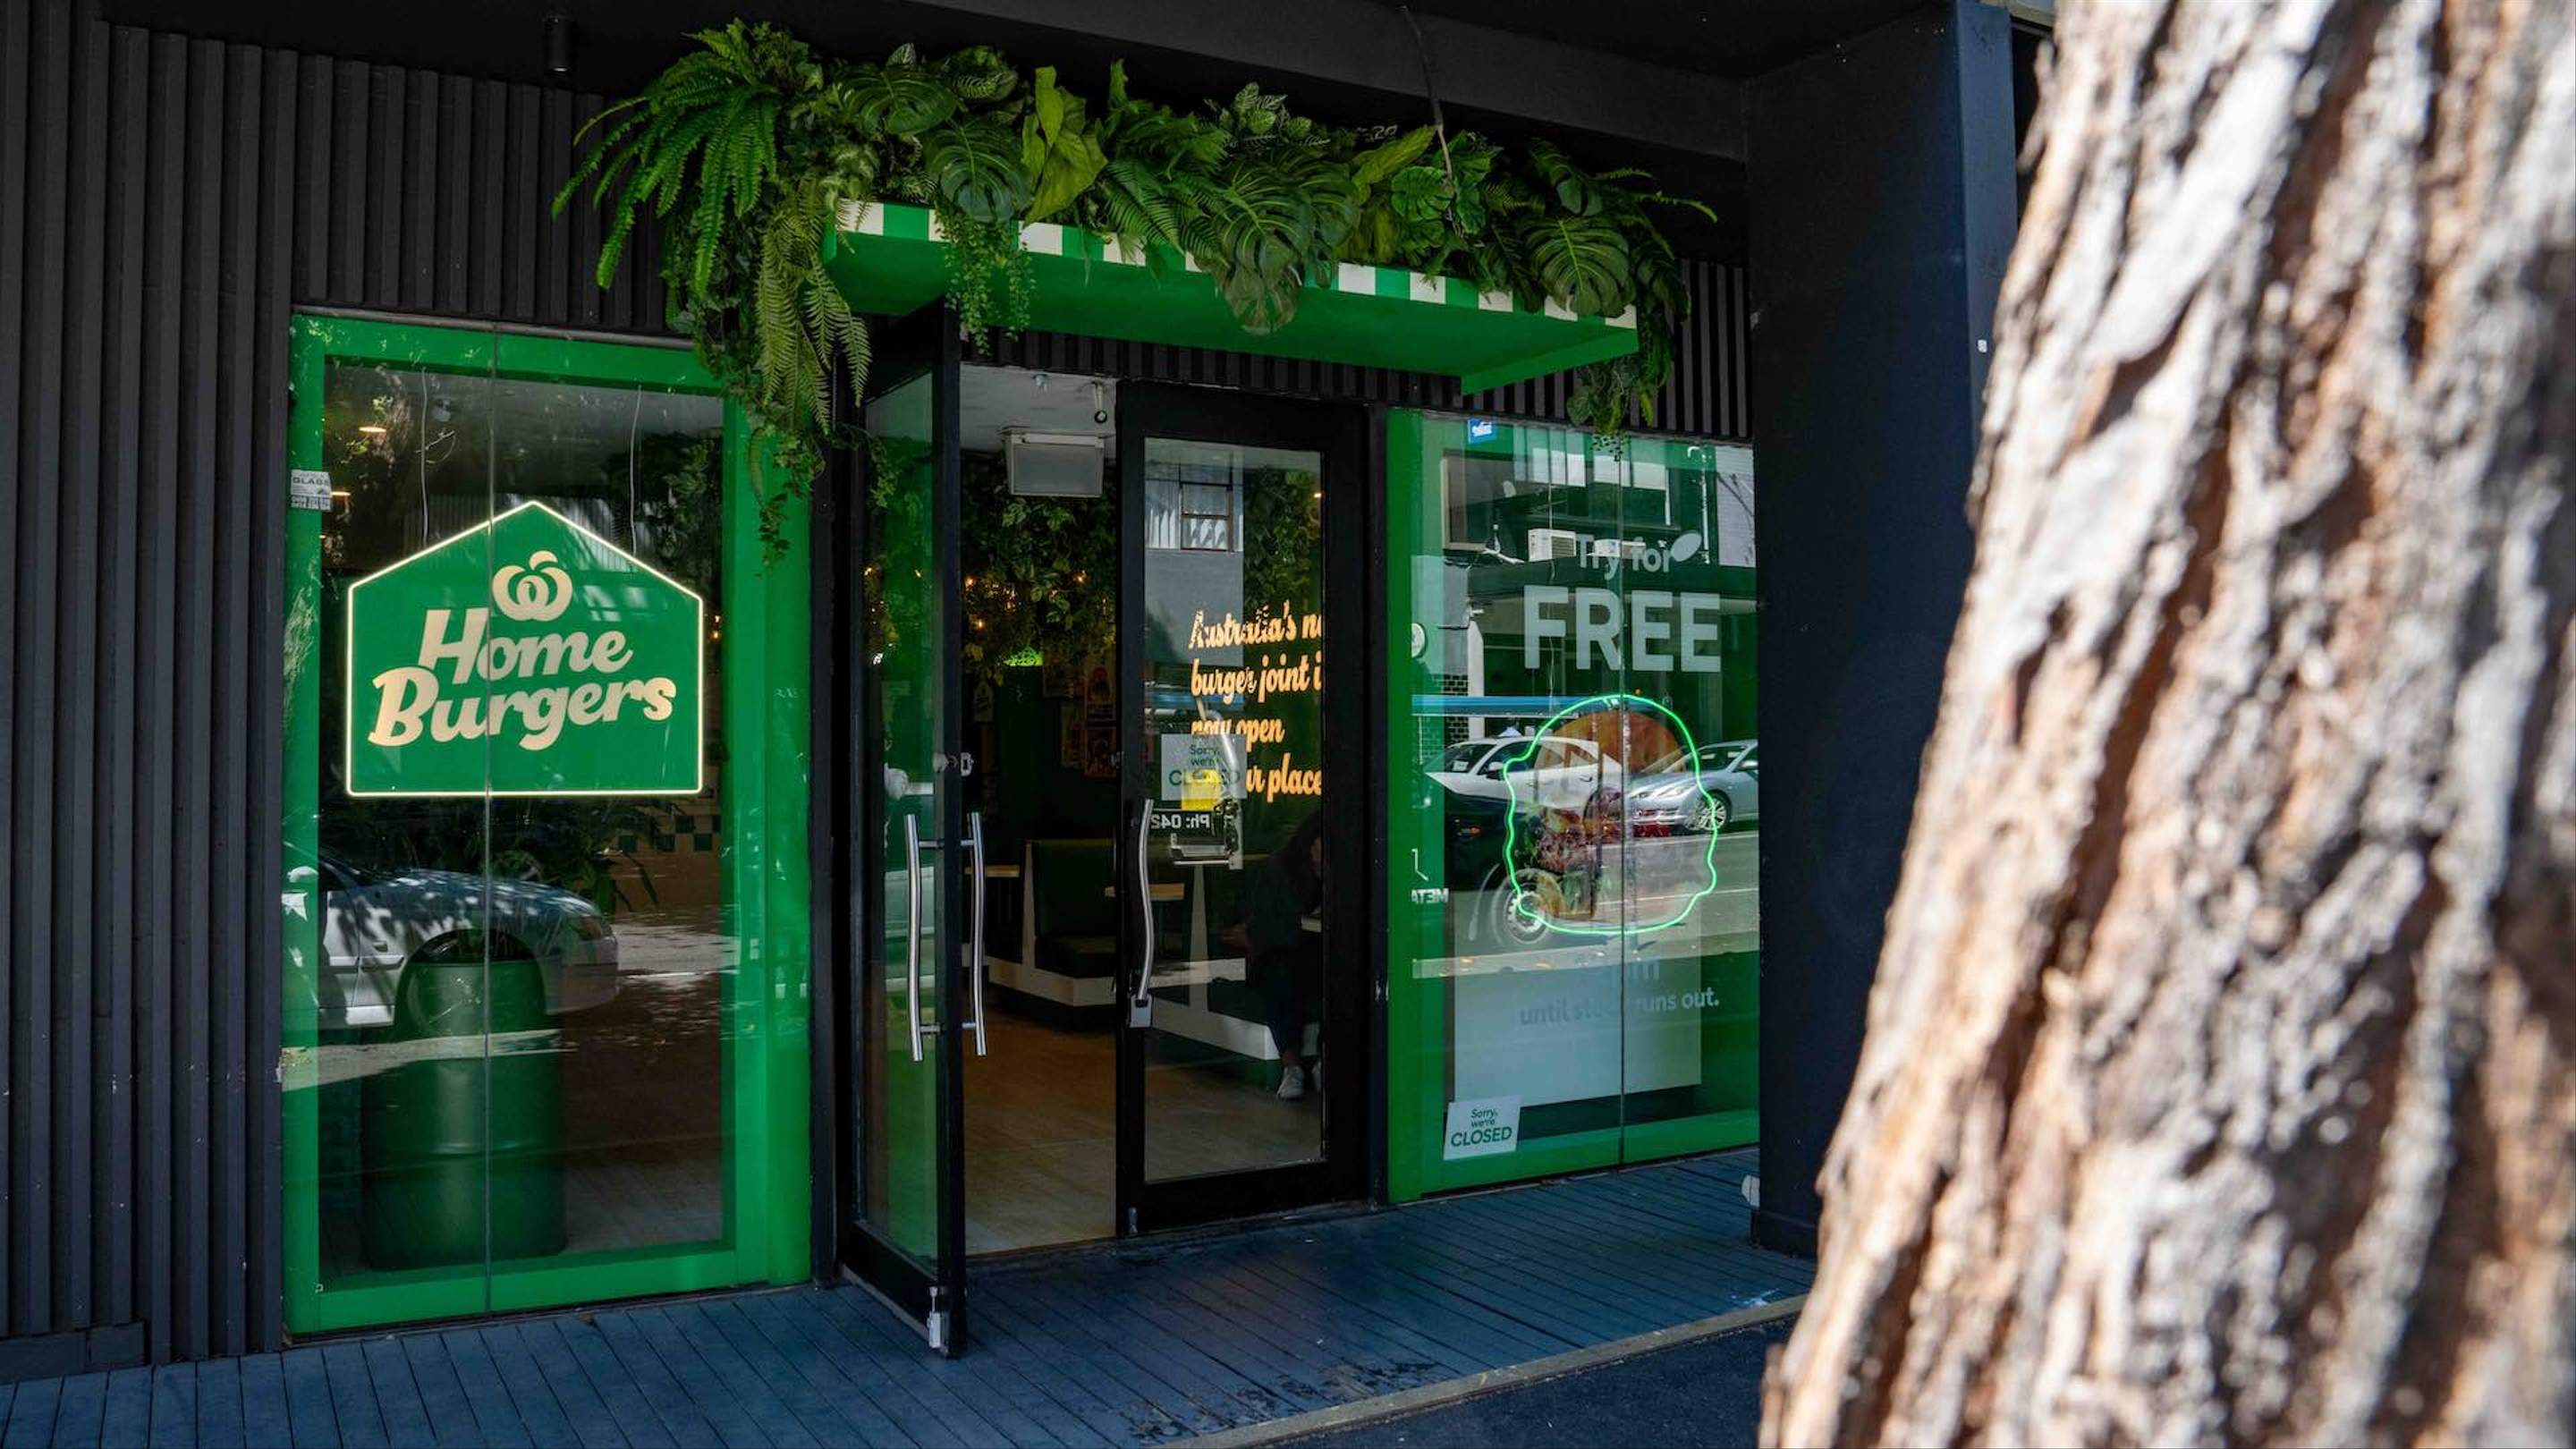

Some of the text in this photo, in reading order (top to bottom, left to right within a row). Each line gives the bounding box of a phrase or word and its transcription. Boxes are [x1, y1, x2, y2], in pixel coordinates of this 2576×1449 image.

[419, 607, 633, 684] Home
[1188, 599, 1296, 649] Australia's
[1523, 585, 1722, 673] FREE
[1191, 658, 1257, 705] burger
[1258, 653, 1310, 703] joint
[368, 666, 676, 750] Burgers
[1235, 718, 1285, 752] open
[1246, 766, 1266, 793] ur
[1519, 994, 1570, 1025] until
[1681, 986, 1720, 1009] out.
[1451, 1126, 1513, 1147] CLOSED
